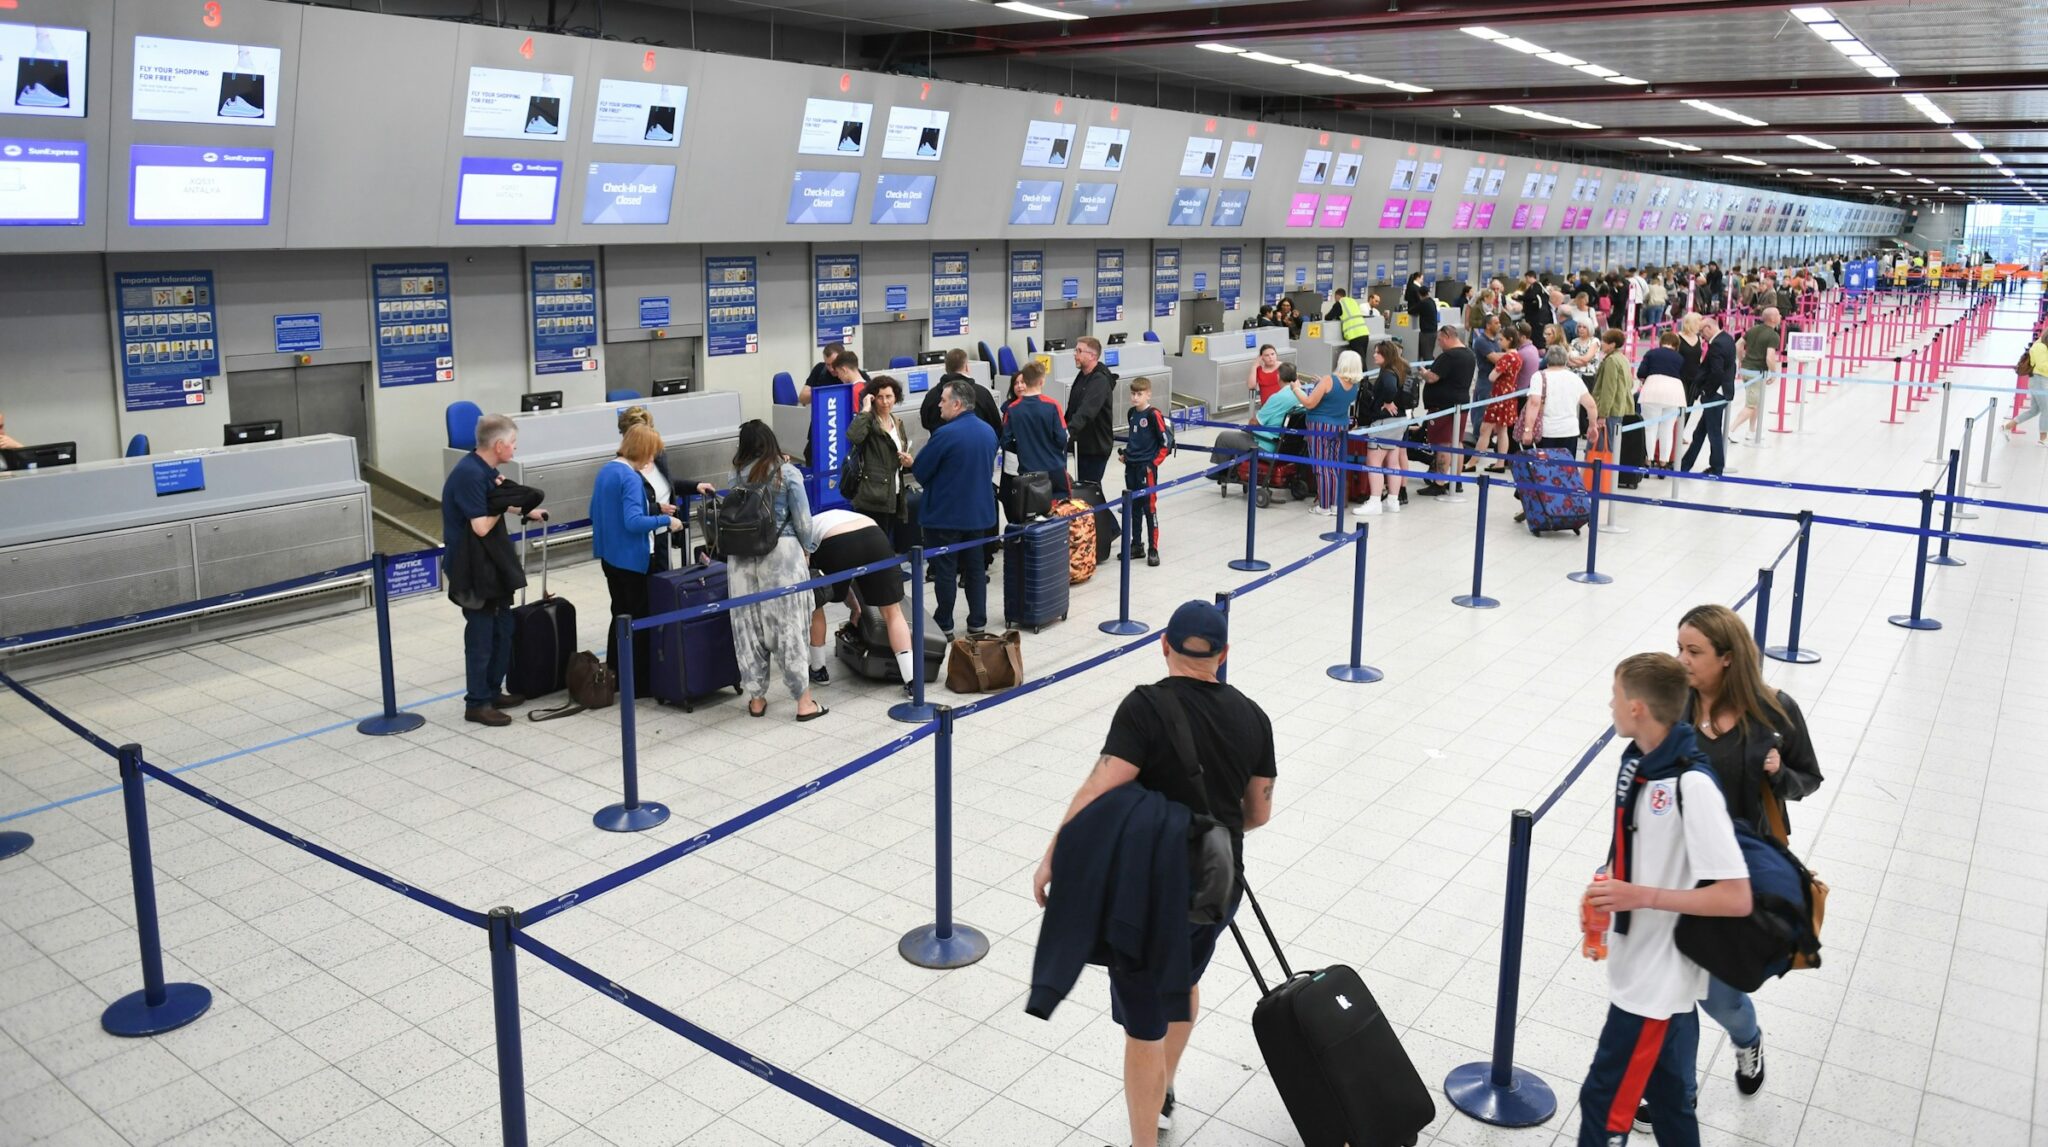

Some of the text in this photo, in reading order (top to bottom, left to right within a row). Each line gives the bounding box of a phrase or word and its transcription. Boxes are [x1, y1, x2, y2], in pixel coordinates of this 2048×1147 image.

[203, 1, 222, 28] 3
[519, 37, 535, 60] 4
[139, 65, 209, 76] FLY YOUR SHOPPING
[139, 73, 154, 81] FOR
[28, 147, 79, 157] SunExpress
[223, 154, 266, 163] SunExpress
[638, 184, 657, 194] Desk
[831, 188, 846, 198] Desk
[909, 190, 922, 199] Desk
[615, 195, 642, 205] Closed
[813, 198, 833, 208] Closed
[893, 200, 911, 209] Closed
[376, 268, 408, 276] Important
[120, 275, 206, 285] Important Information
[828, 397, 838, 478] RYANAIR
[395, 560, 422, 570] NOTICE
